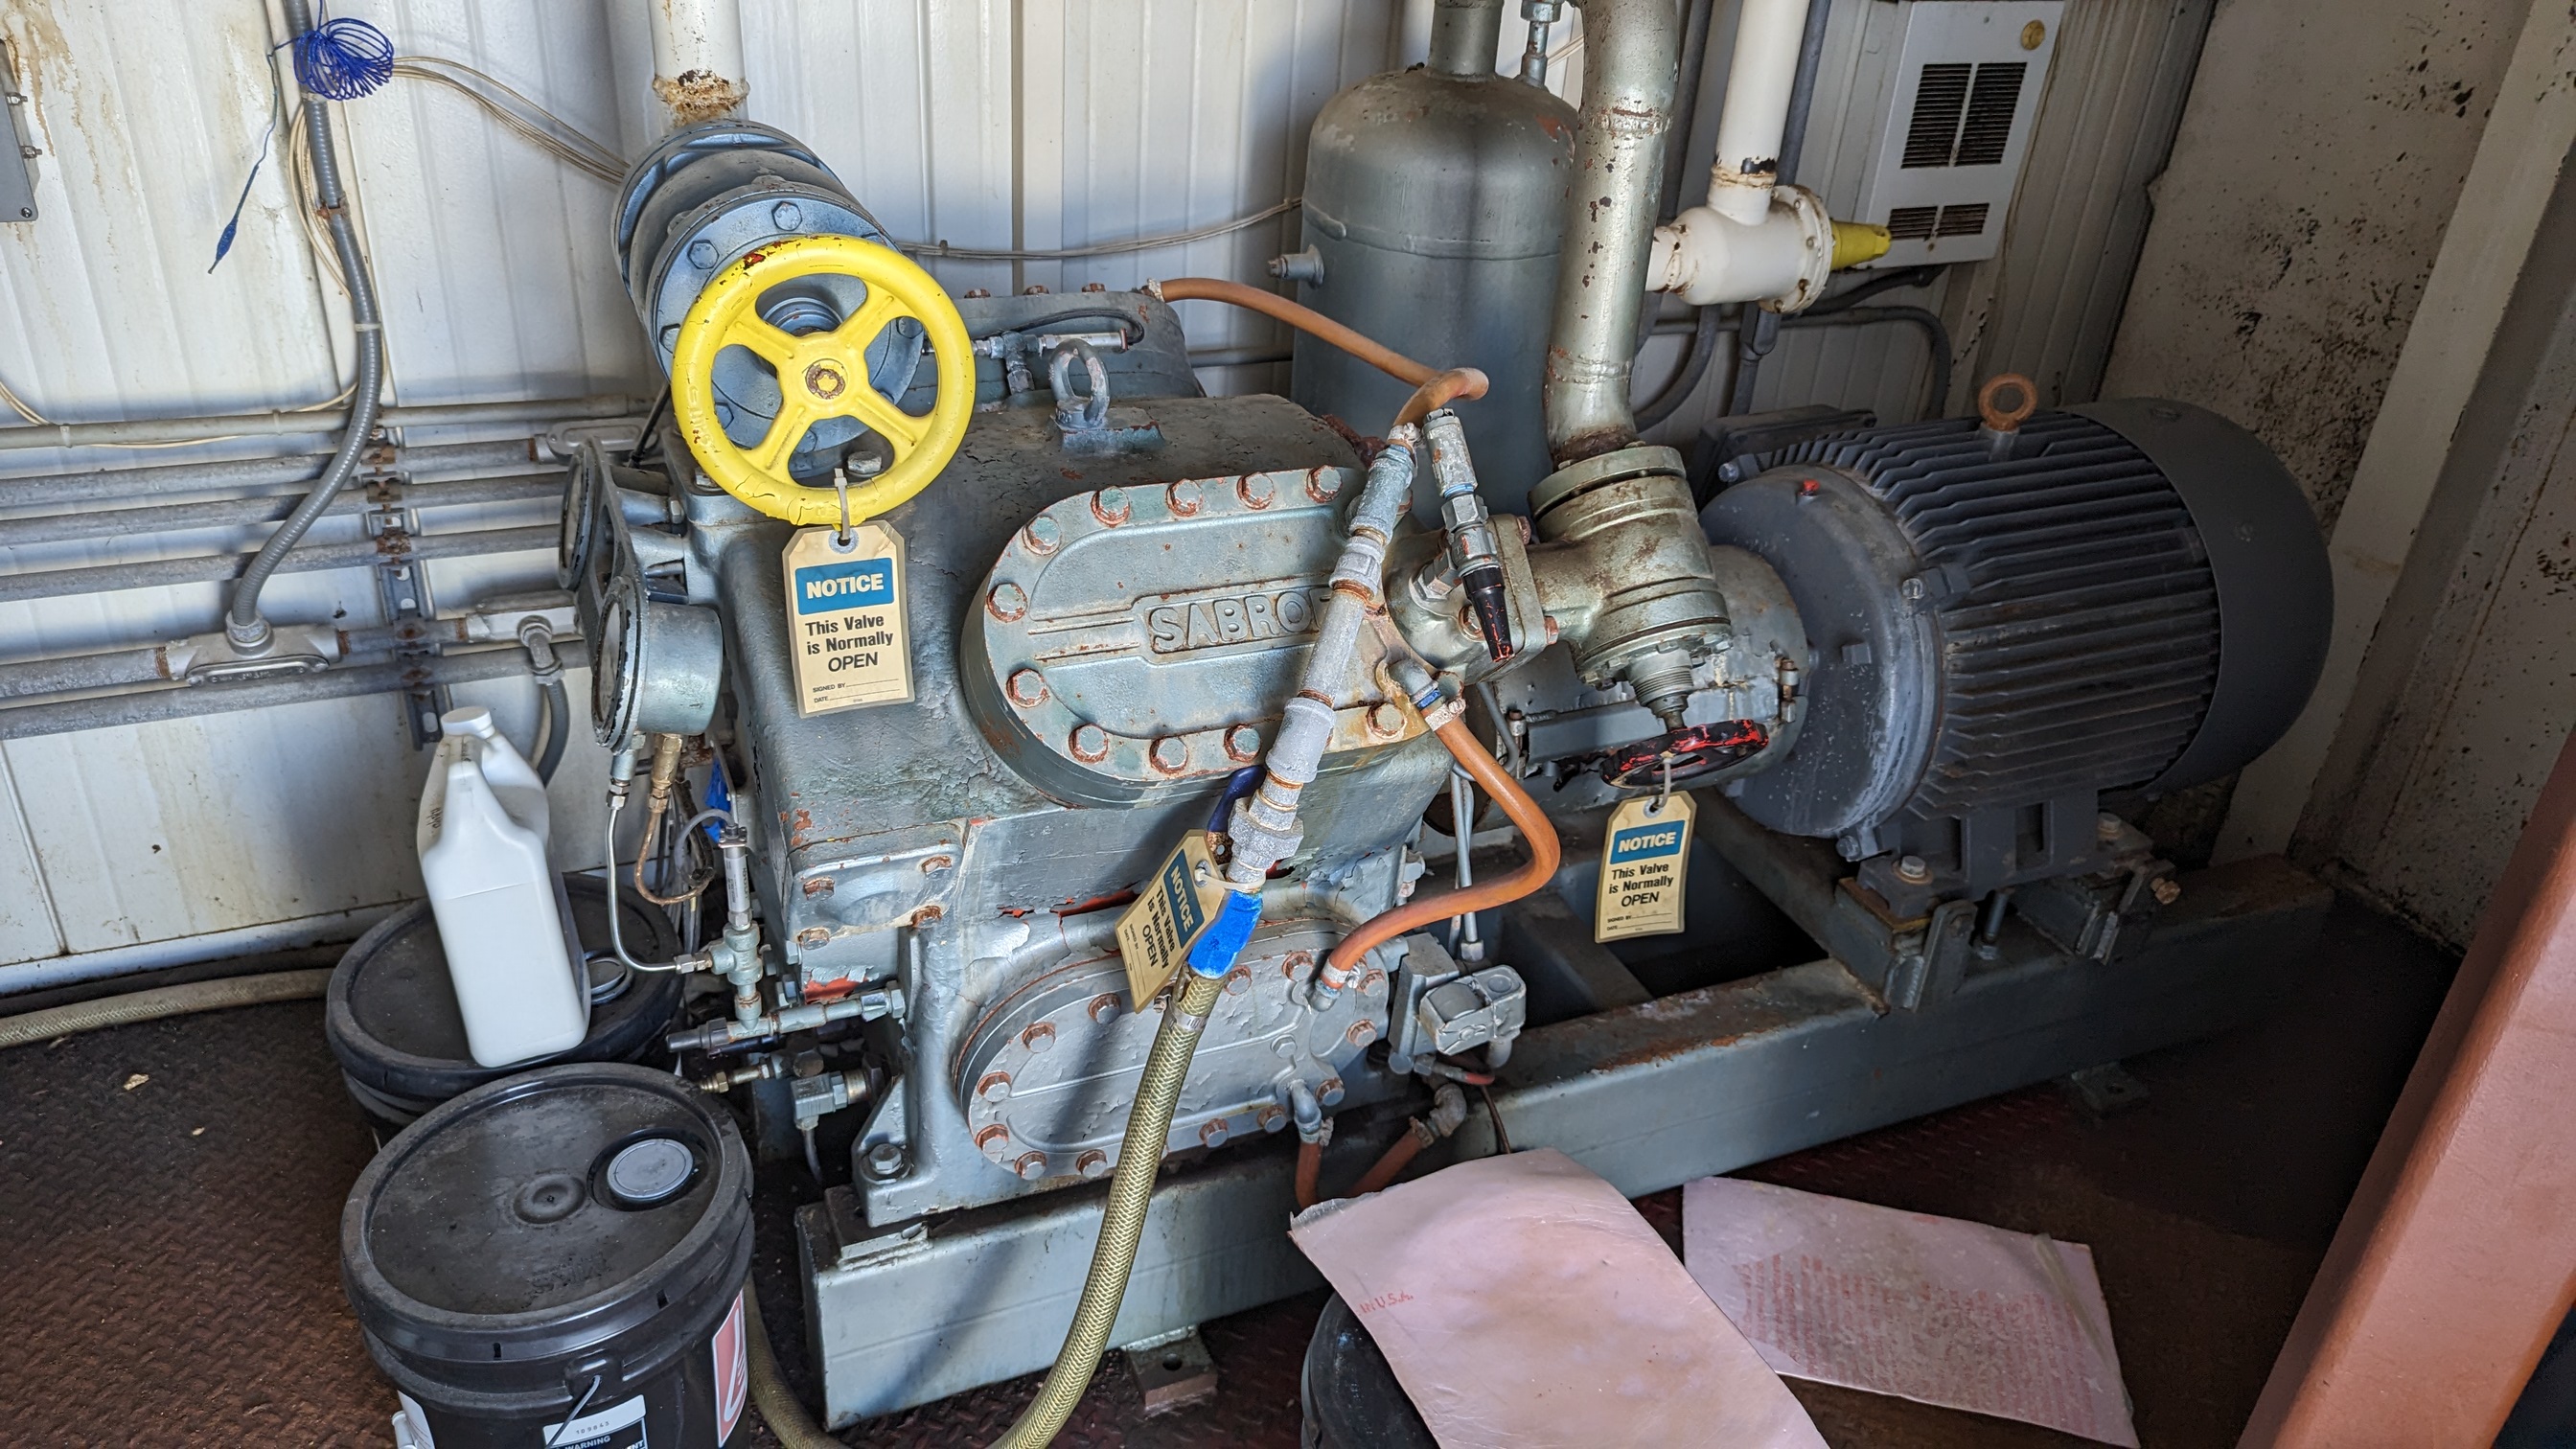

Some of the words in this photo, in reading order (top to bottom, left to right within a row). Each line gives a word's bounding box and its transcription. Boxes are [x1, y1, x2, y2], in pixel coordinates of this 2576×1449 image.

[806, 573, 885, 599] NOTICE
[805, 620, 839, 636] This
[843, 614, 885, 632] Valve
[807, 641, 820, 656] is
[826, 631, 894, 653] Normally
[828, 652, 879, 672] OPEN
[813, 683, 835, 694] SIGNED
[1618, 832, 1677, 854] NOTICE
[1611, 867, 1635, 881] This
[1640, 863, 1669, 876] Valve
[1609, 884, 1619, 894] is
[1622, 875, 1674, 892] Normally
[1170, 864, 1194, 932] NOTICE
[1621, 891, 1660, 908] OPEN
[1156, 886, 1166, 917] This
[1164, 914, 1176, 953] Valve
[1147, 896, 1155, 912] is
[1152, 910, 1169, 969] Normally
[1142, 924, 1159, 967] OPEN
